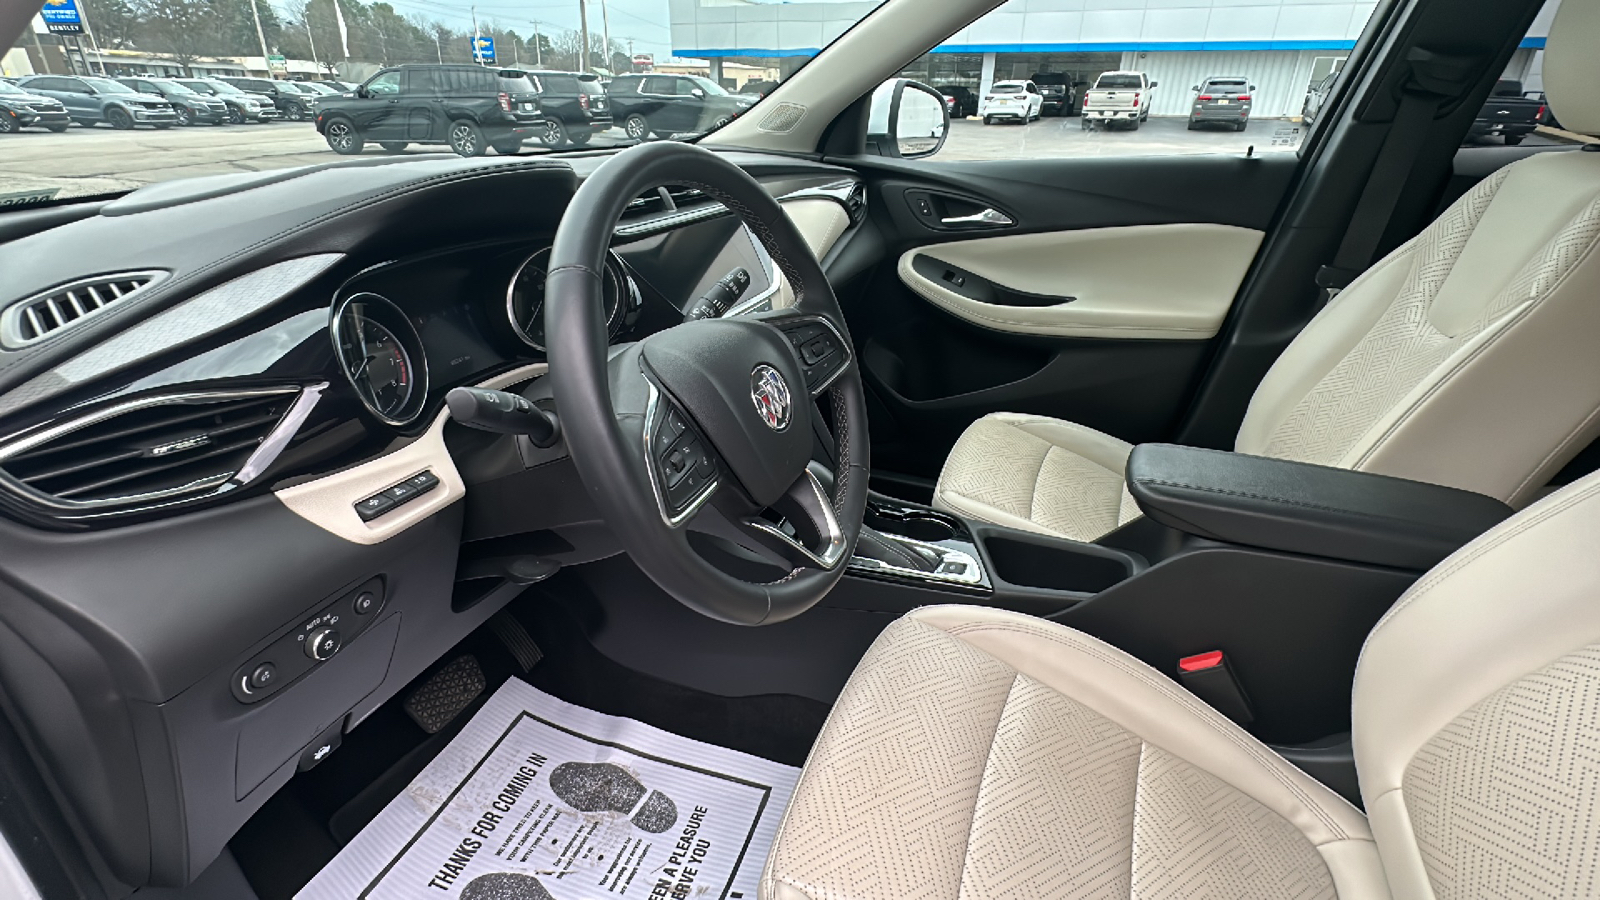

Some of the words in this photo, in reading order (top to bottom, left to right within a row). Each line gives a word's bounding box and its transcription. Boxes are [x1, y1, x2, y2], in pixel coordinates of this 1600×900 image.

[307, 618, 320, 630] AUTO
[428, 837, 483, 891] THANKS
[471, 811, 504, 839] FOR
[492, 766, 538, 813] COMING
[526, 752, 548, 768] IN
[668, 805, 708, 866] PLEASURE
[688, 838, 711, 864] YOU
[663, 867, 678, 878] A
